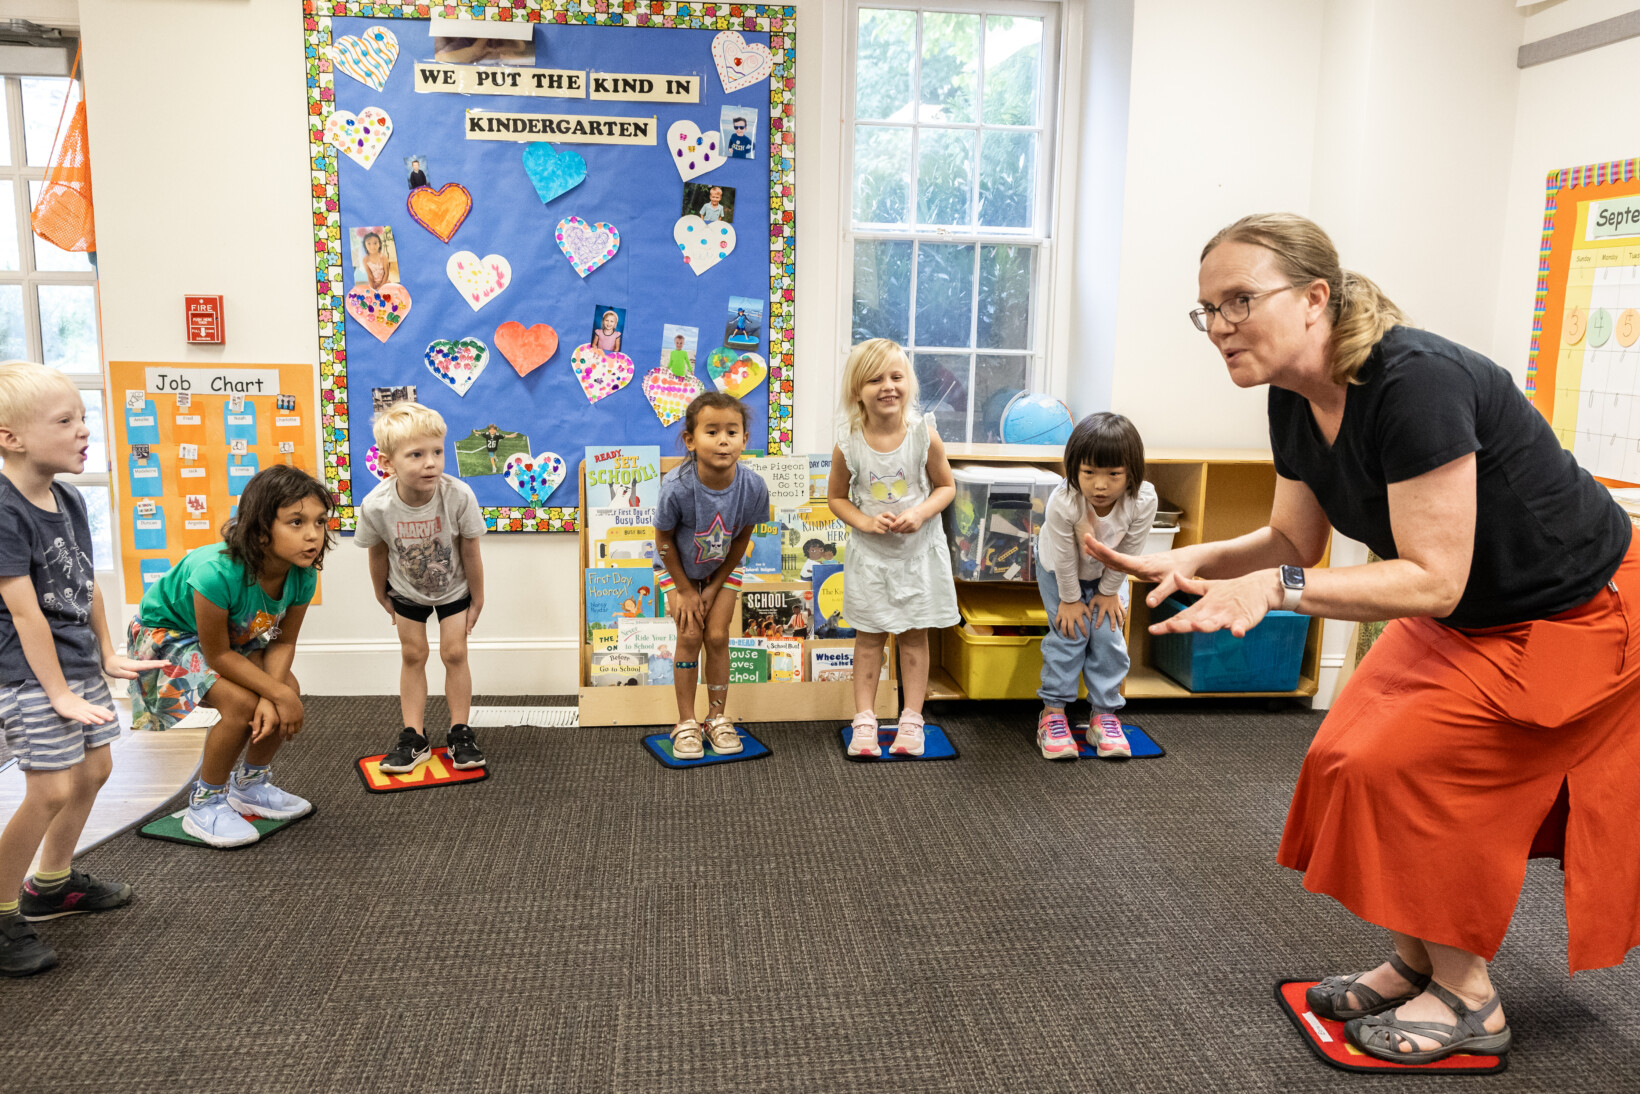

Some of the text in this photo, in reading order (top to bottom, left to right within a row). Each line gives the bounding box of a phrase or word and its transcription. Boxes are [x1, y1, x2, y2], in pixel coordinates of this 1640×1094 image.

[420, 69, 691, 95] WE PUT THE KIND IN
[469, 117, 649, 138] KINDERGARTEN
[1596, 206, 1640, 231] Septe
[191, 304, 213, 312] FIRE
[1569, 314, 1578, 336] 3
[1594, 315, 1604, 337] 4
[1623, 314, 1634, 337] 5
[156, 374, 264, 393] Job Chart
[487, 440, 497, 448] 26
[770, 463, 804, 471] Pigeon
[588, 463, 658, 487] SCHOOL!
[633, 508, 643, 516] Day
[615, 515, 652, 526] Busy Bus!
[398, 519, 441, 538] MARVEL
[761, 523, 778, 535] Dog
[827, 531, 849, 541] HERO
[588, 572, 633, 587] First Day,
[589, 585, 628, 598] Hooray!
[747, 593, 788, 608] SCHOOL
[621, 627, 638, 636] Never
[599, 635, 614, 643] THE
[729, 649, 758, 659] ouse
[816, 653, 849, 661] Wheels
[730, 661, 754, 670] oves
[729, 671, 759, 682] chool
